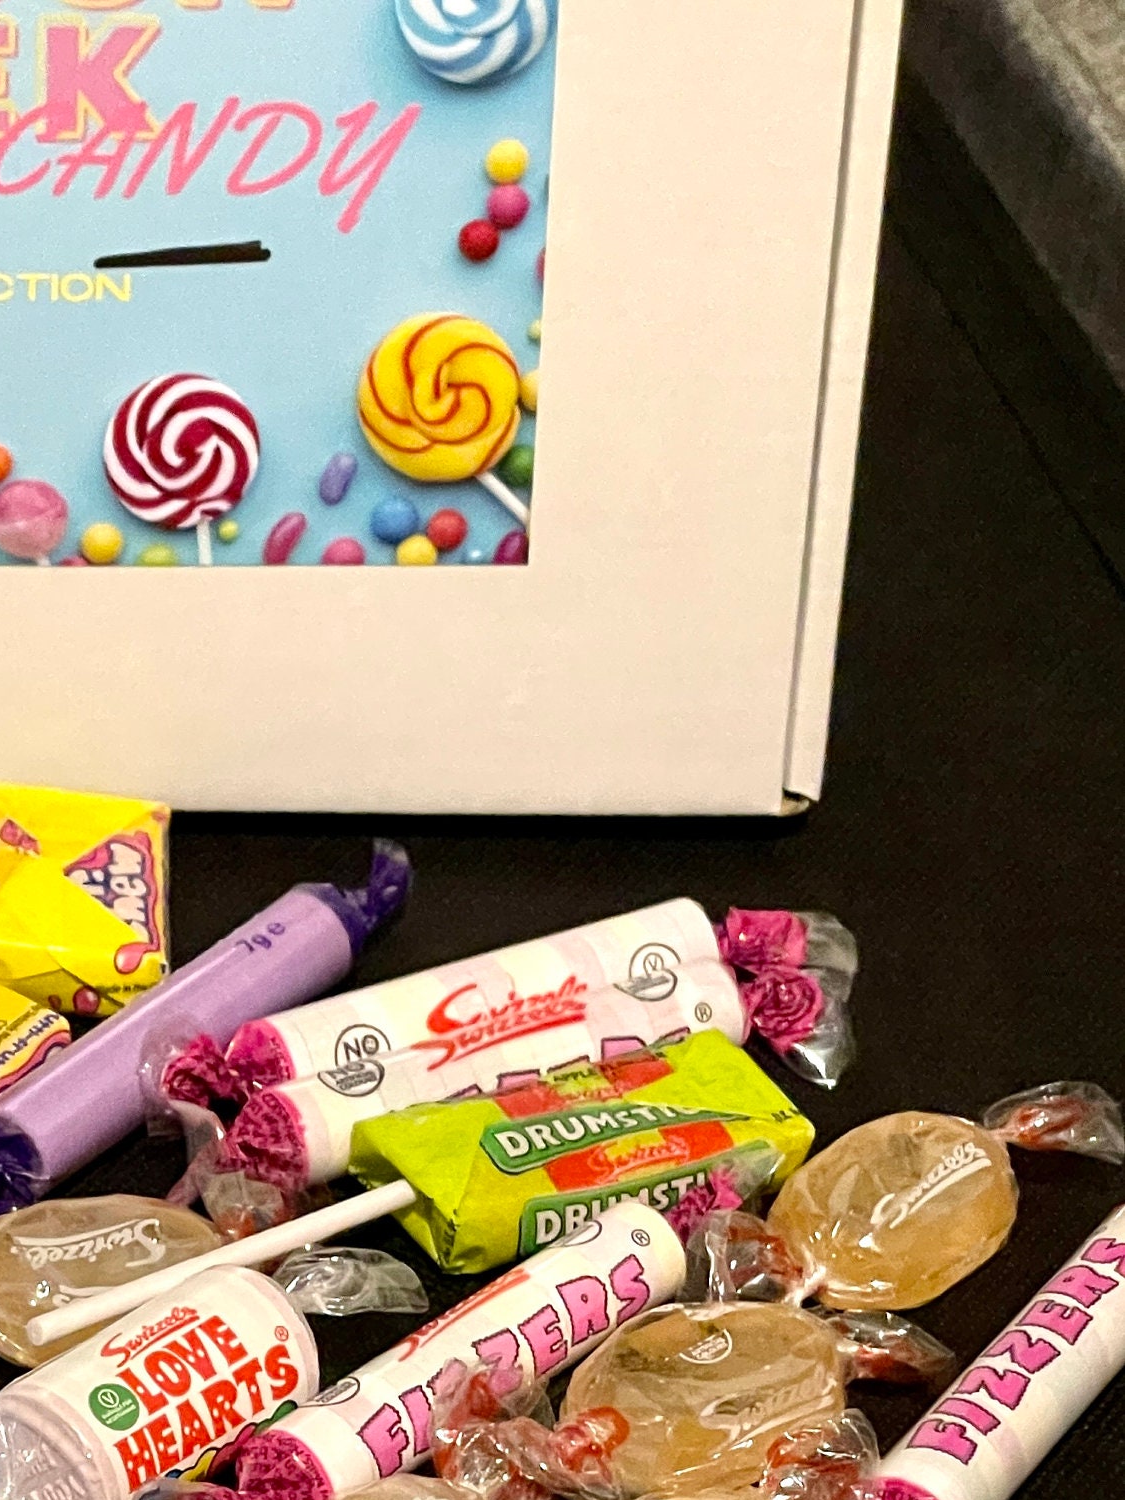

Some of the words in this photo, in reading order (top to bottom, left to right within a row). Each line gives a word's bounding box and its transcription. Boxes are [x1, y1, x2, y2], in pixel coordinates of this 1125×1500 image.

[493, 1104, 700, 1159] DRUMSTI
[10, 1218, 166, 1269] Swizzels
[100, 1304, 201, 1368] Swizzels
[115, 1314, 249, 1417] LOVE
[906, 1236, 1125, 1467] FIZZERS
[112, 1344, 300, 1495] HEARTS
